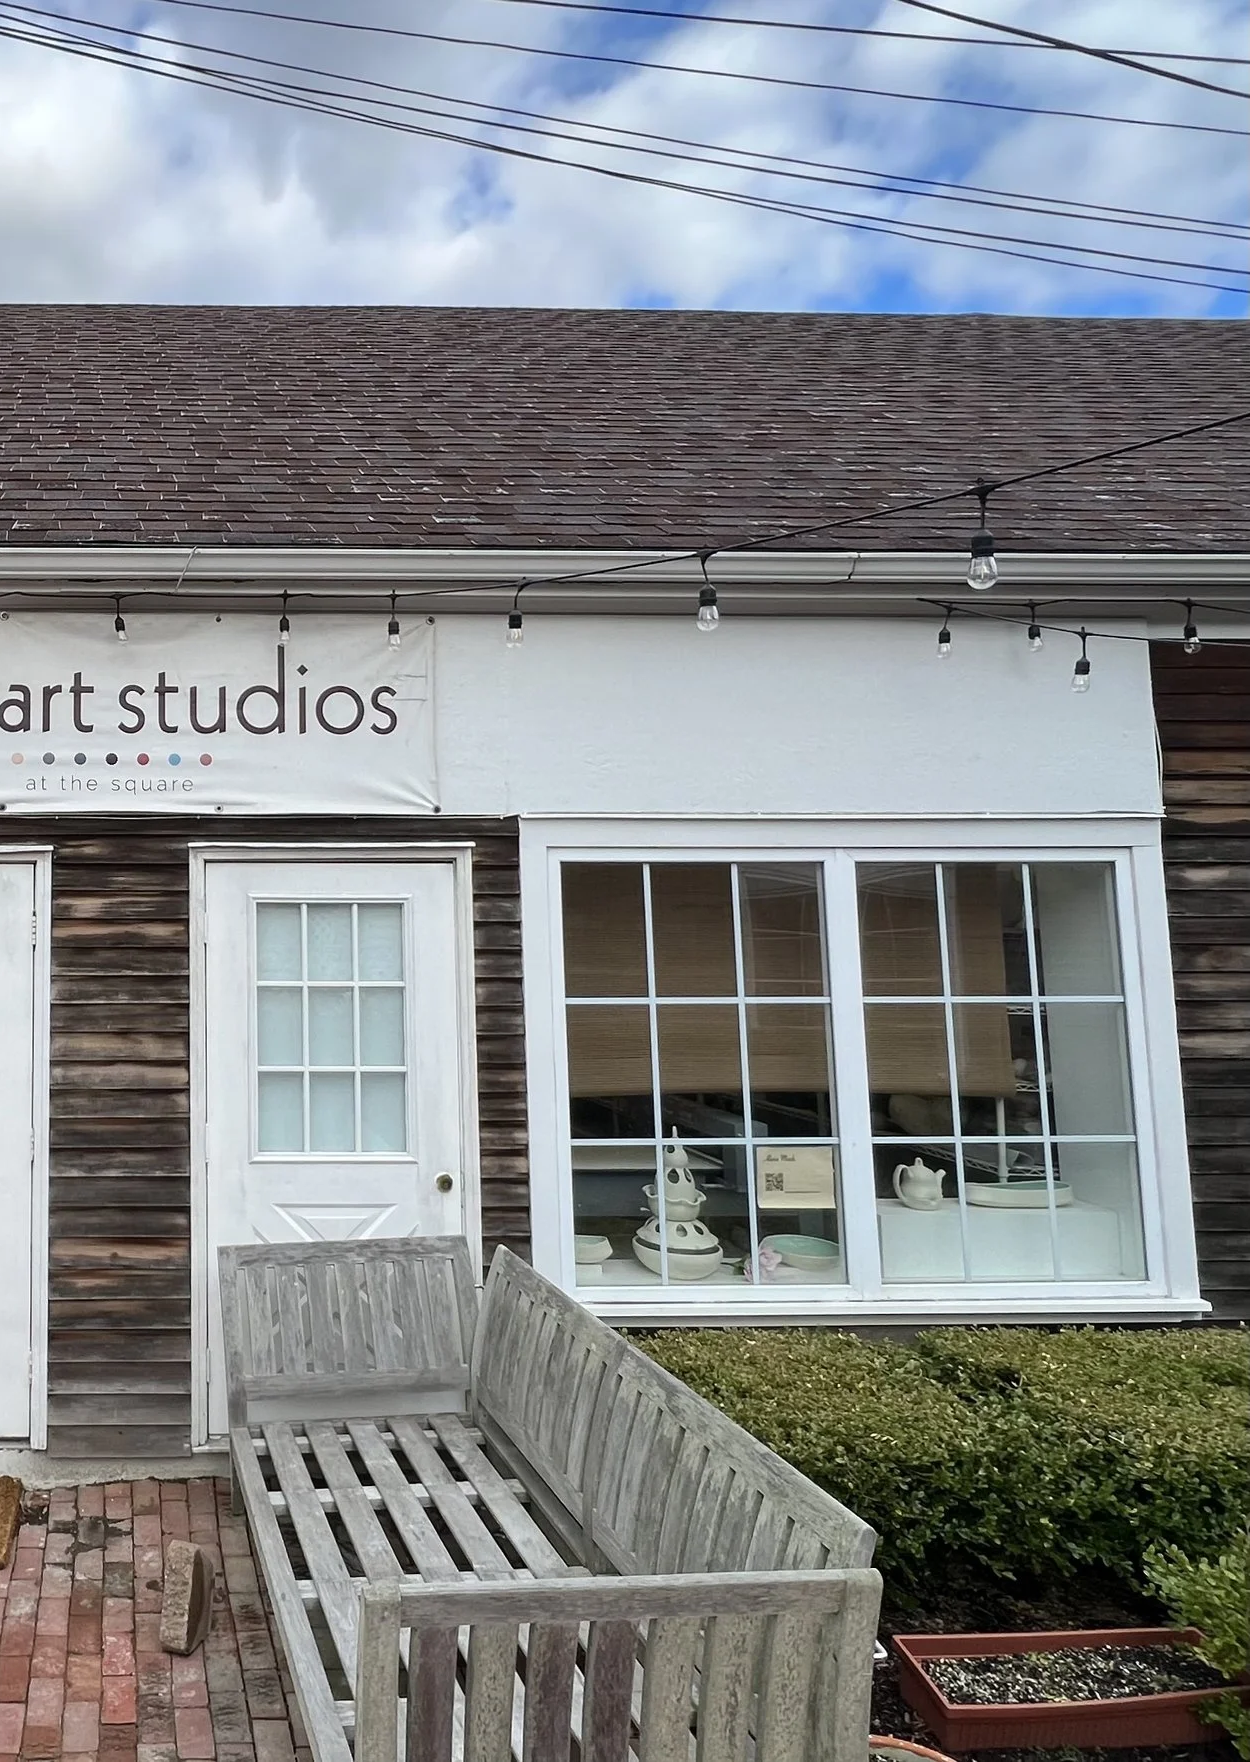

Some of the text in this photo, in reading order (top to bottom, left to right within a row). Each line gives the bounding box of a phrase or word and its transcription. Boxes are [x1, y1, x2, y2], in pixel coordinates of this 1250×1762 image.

[117, 644, 398, 735] studios
[25, 775, 195, 796] at the square
